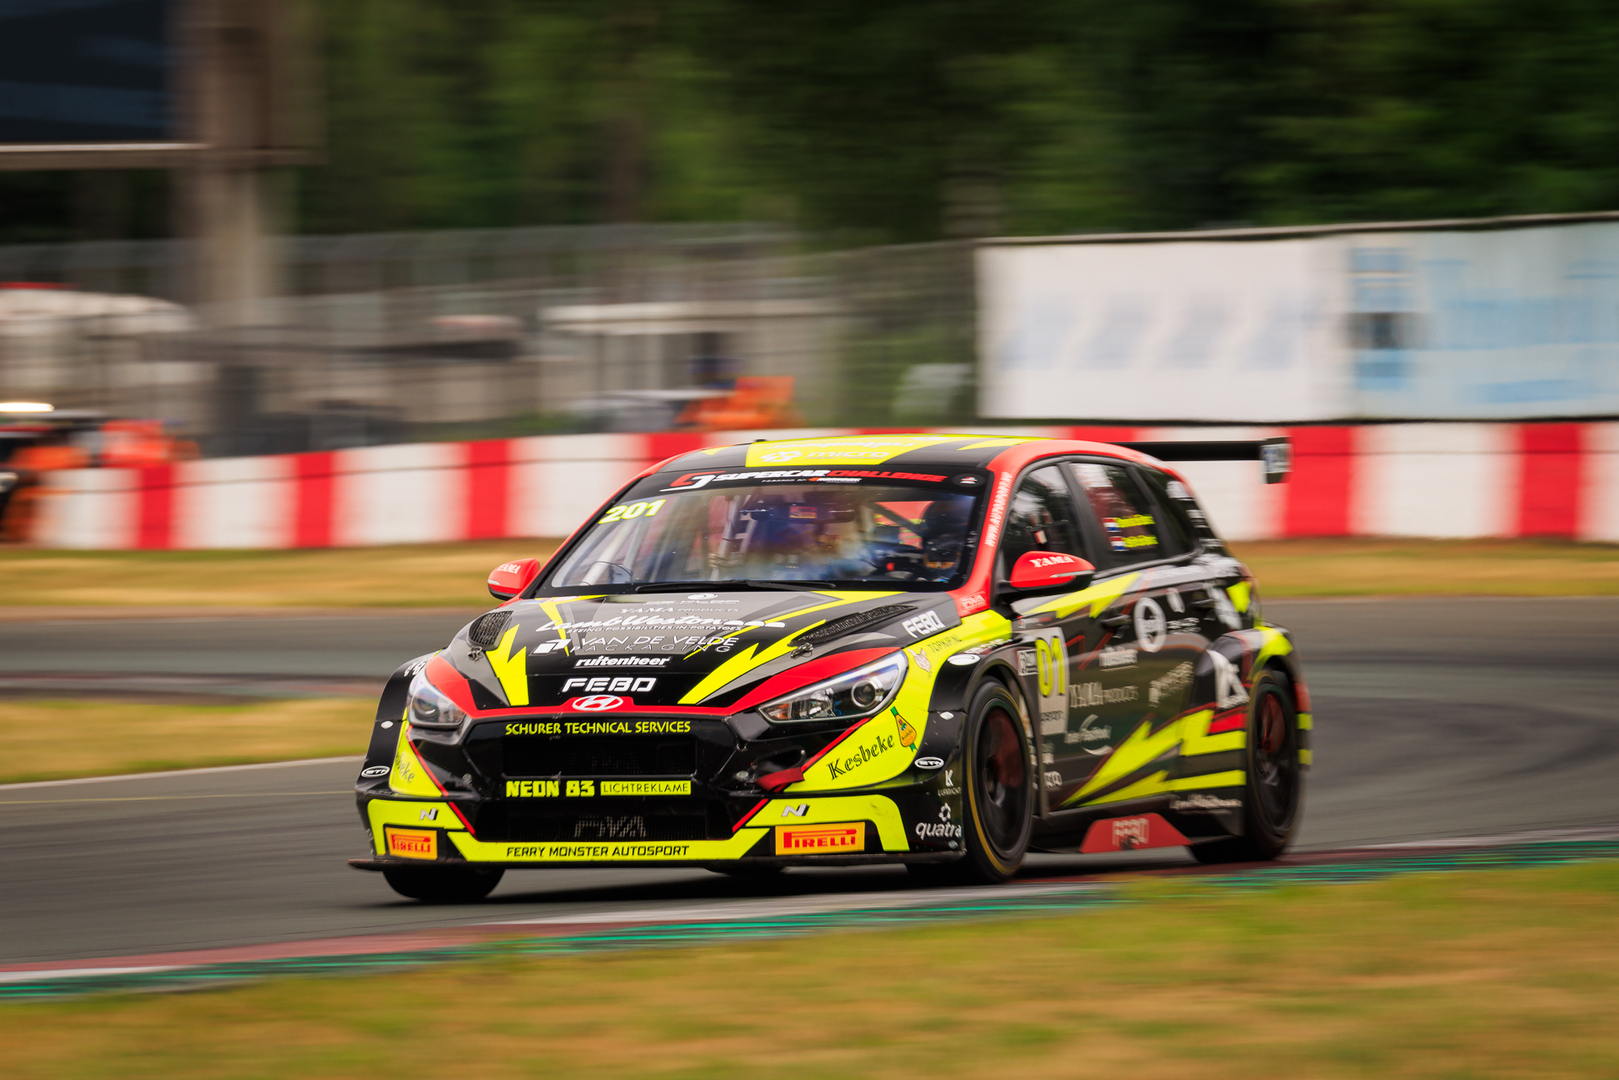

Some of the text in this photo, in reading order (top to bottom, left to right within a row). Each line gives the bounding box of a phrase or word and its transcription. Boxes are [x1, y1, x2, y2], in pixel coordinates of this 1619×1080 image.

[598, 499, 666, 524] 201
[1029, 555, 1075, 568] YAMA
[902, 610, 946, 638] FEBO
[569, 644, 731, 653] PACKAGING
[581, 636, 739, 647] VAN DE VELDE
[575, 656, 672, 667] ruitenheer
[561, 677, 657, 693] FEBO
[505, 721, 691, 735] SCHURER TECHNICAL SERVICES
[826, 733, 895, 780] Kesbeke
[505, 780, 689, 797] NEON 83 LICHTREKLAME
[391, 833, 431, 853] PIRELLI
[783, 828, 857, 848] PIRELLI
[506, 845, 690, 858] FERRY MONSTER AUTOSPORT
